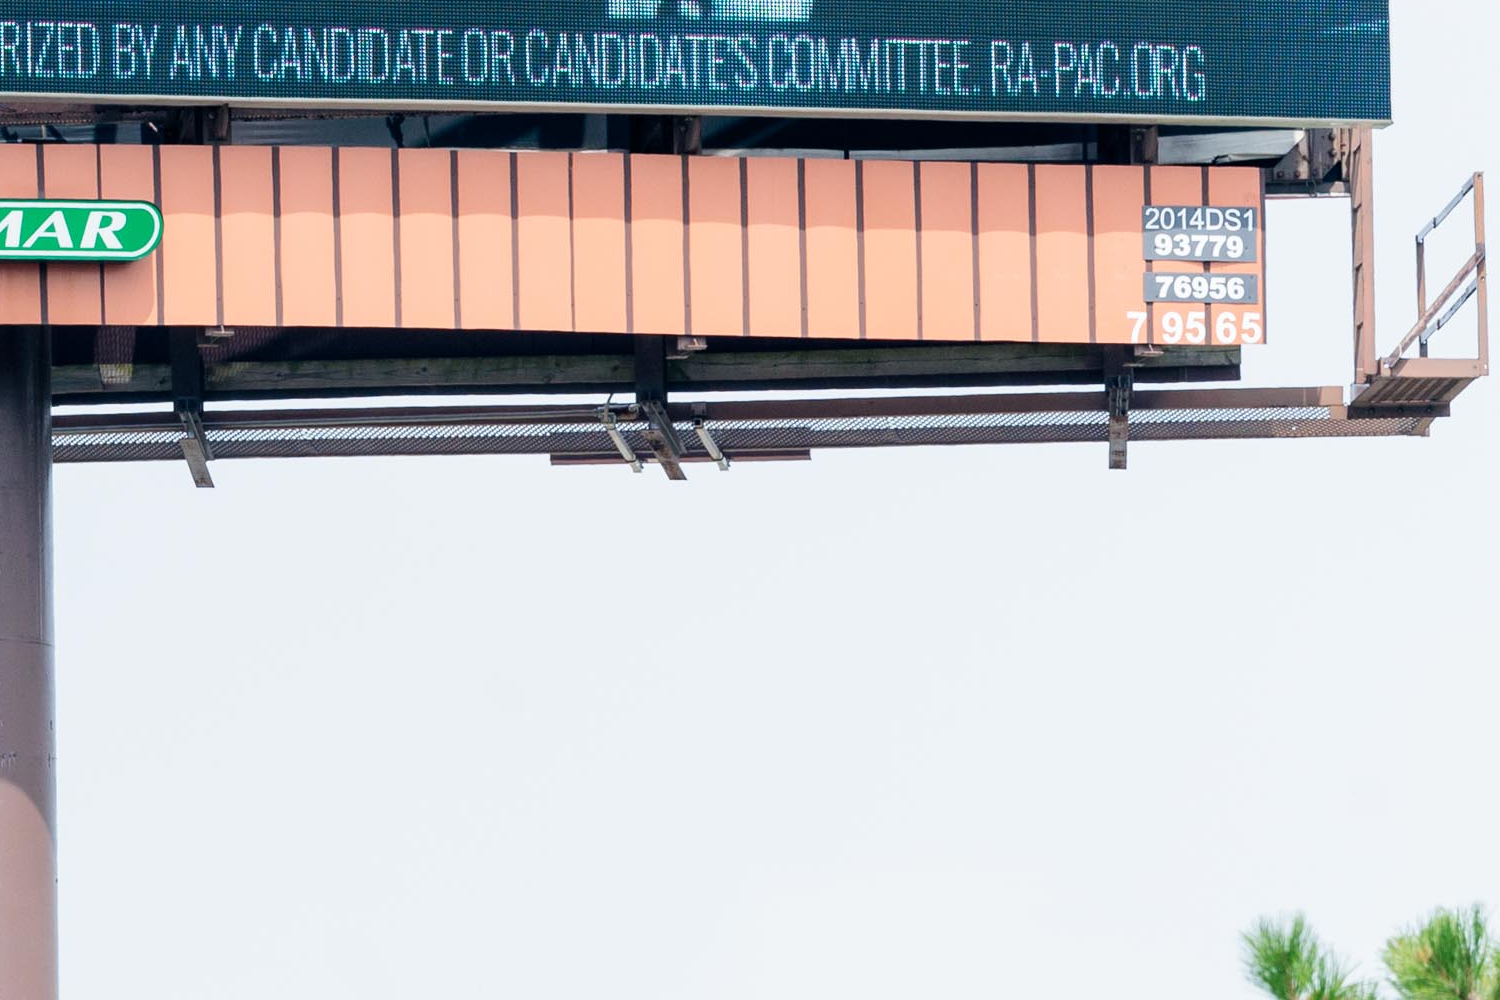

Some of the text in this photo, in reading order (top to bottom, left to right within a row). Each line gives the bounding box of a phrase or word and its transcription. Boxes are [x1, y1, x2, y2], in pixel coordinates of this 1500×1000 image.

[114, 24, 158, 79] BY
[169, 25, 240, 81] ANY
[253, 24, 454, 86] CANDIDATE
[462, 28, 515, 86] OR
[768, 34, 980, 95] COMMITTEE.
[990, 38, 1206, 102] RA-PAC.ORG
[1144, 207, 1254, 232] 2014DS1
[1154, 233, 1244, 259] 93779
[1155, 275, 1245, 300] 76956
